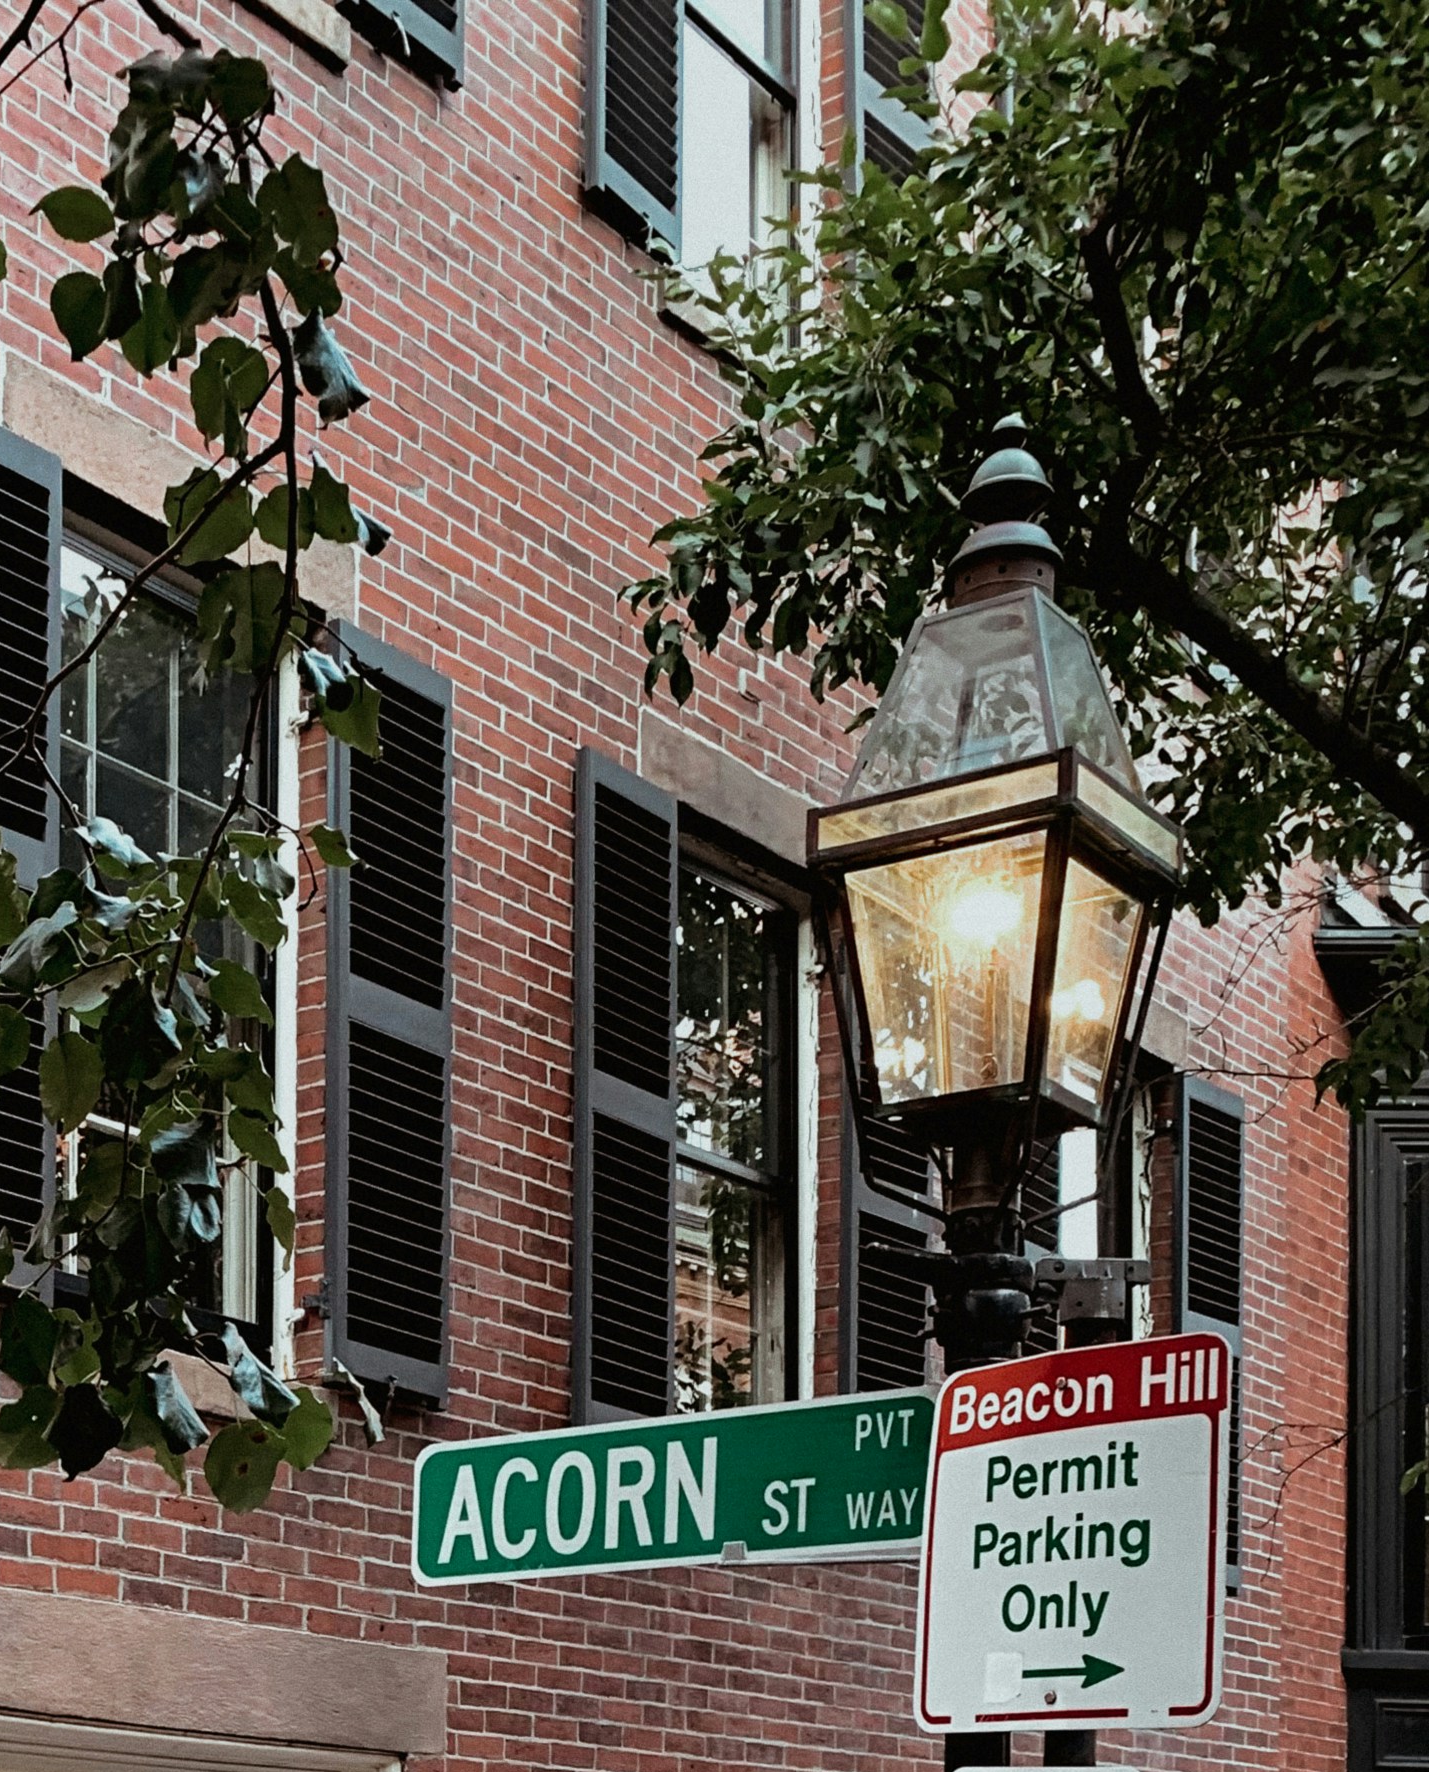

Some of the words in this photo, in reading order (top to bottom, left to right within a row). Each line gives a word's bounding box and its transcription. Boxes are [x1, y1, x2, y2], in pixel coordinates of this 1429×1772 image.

[948, 1374, 1114, 1435] Beacon
[1139, 1347, 1220, 1408] Hill
[853, 1408, 915, 1451] PVT
[985, 1440, 1139, 1502] Permit
[437, 1437, 718, 1564] ACORN
[762, 1477, 816, 1536] ST
[846, 1487, 918, 1531] WAY
[973, 1512, 1151, 1569] Parking
[1001, 1580, 1110, 1637] Only
